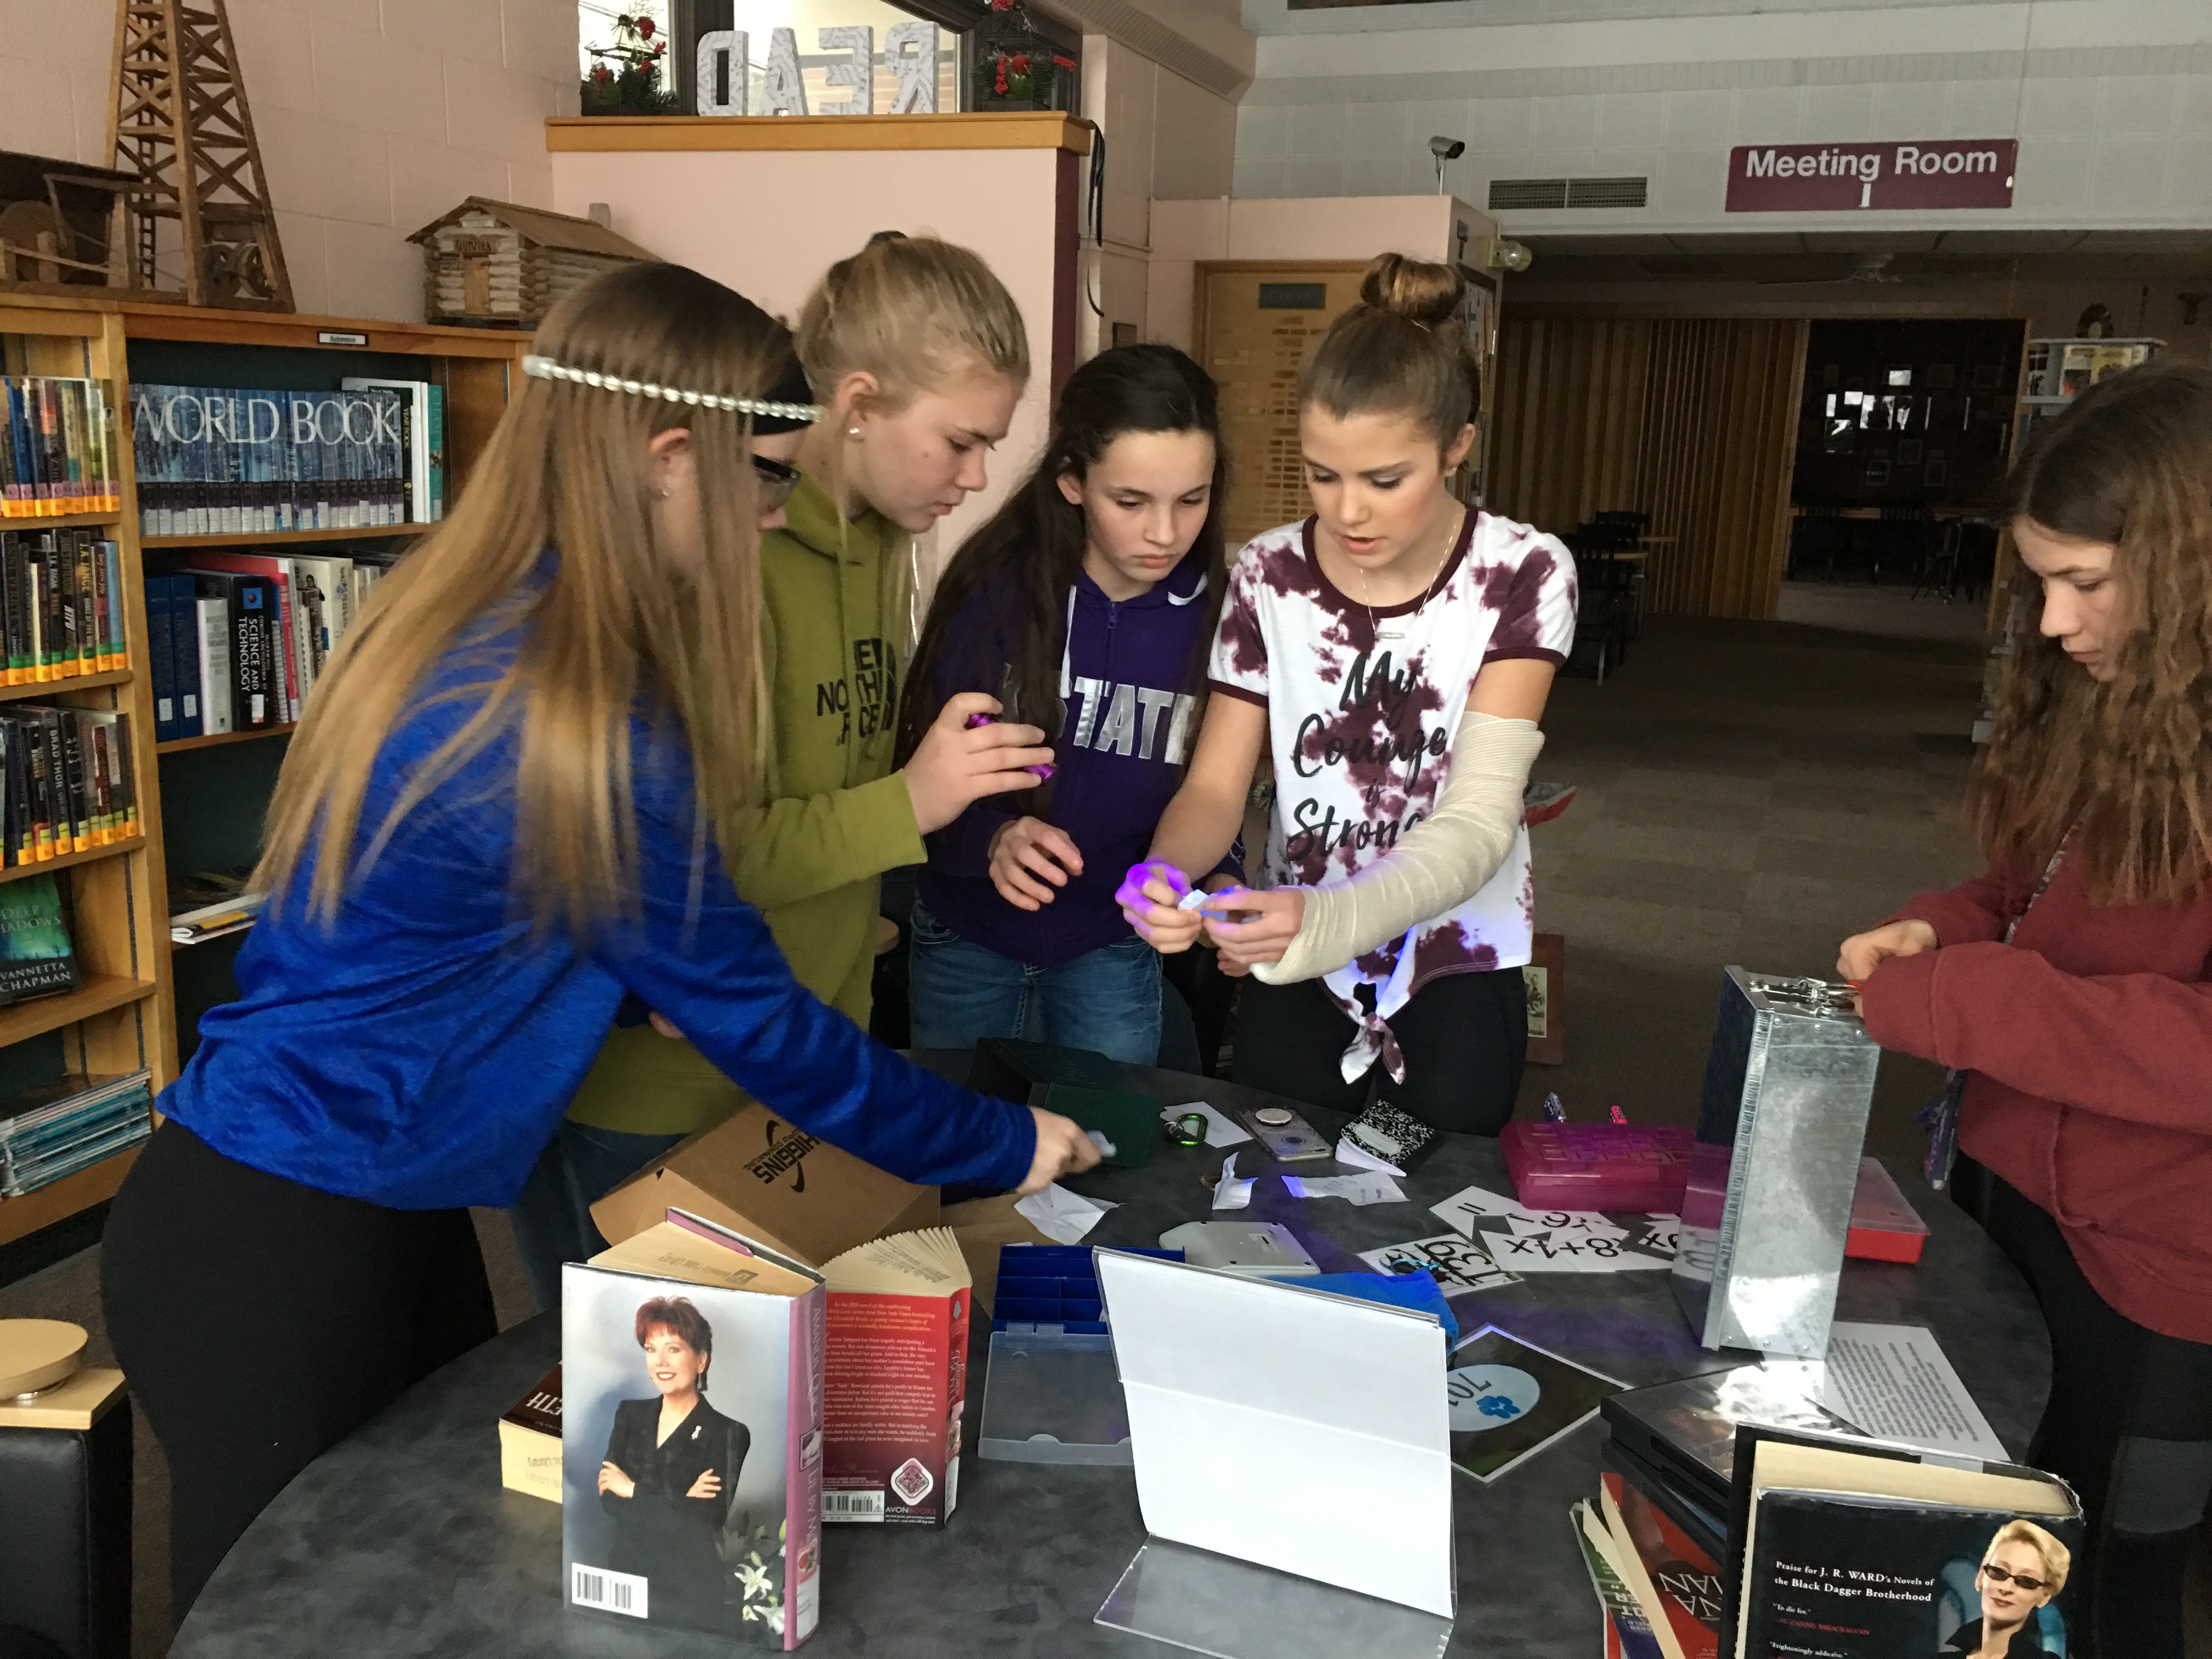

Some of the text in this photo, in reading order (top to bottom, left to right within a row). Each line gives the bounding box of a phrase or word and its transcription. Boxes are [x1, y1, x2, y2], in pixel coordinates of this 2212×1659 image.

[1746, 146, 1997, 182] Meeting Room
[132, 394, 280, 445] WORLD
[292, 399, 401, 445] BOOK
[239, 617, 250, 691] TECHNOLOGY
[249, 619, 260, 690] SCIENCE AND
[1340, 651, 1417, 729] My
[50, 730, 63, 788] BRAD THOR
[1293, 713, 1447, 792] Courage
[1366, 779, 1386, 805] is
[0, 916, 61, 933] HADOWS
[0, 962, 66, 980] VANNETTA
[0, 971, 71, 991] CHAPMAN
[751, 1131, 821, 1185] HIGGINS
[808, 1307, 822, 1422] AMANDA QUICK
[807, 1497, 817, 1513] BY
[1774, 1577, 1932, 1602] the Black Dagger Brotherhood
[1776, 1561, 1936, 1586] Praise for J. R. WARD's Novels of
[1786, 1605, 1796, 1613] die
